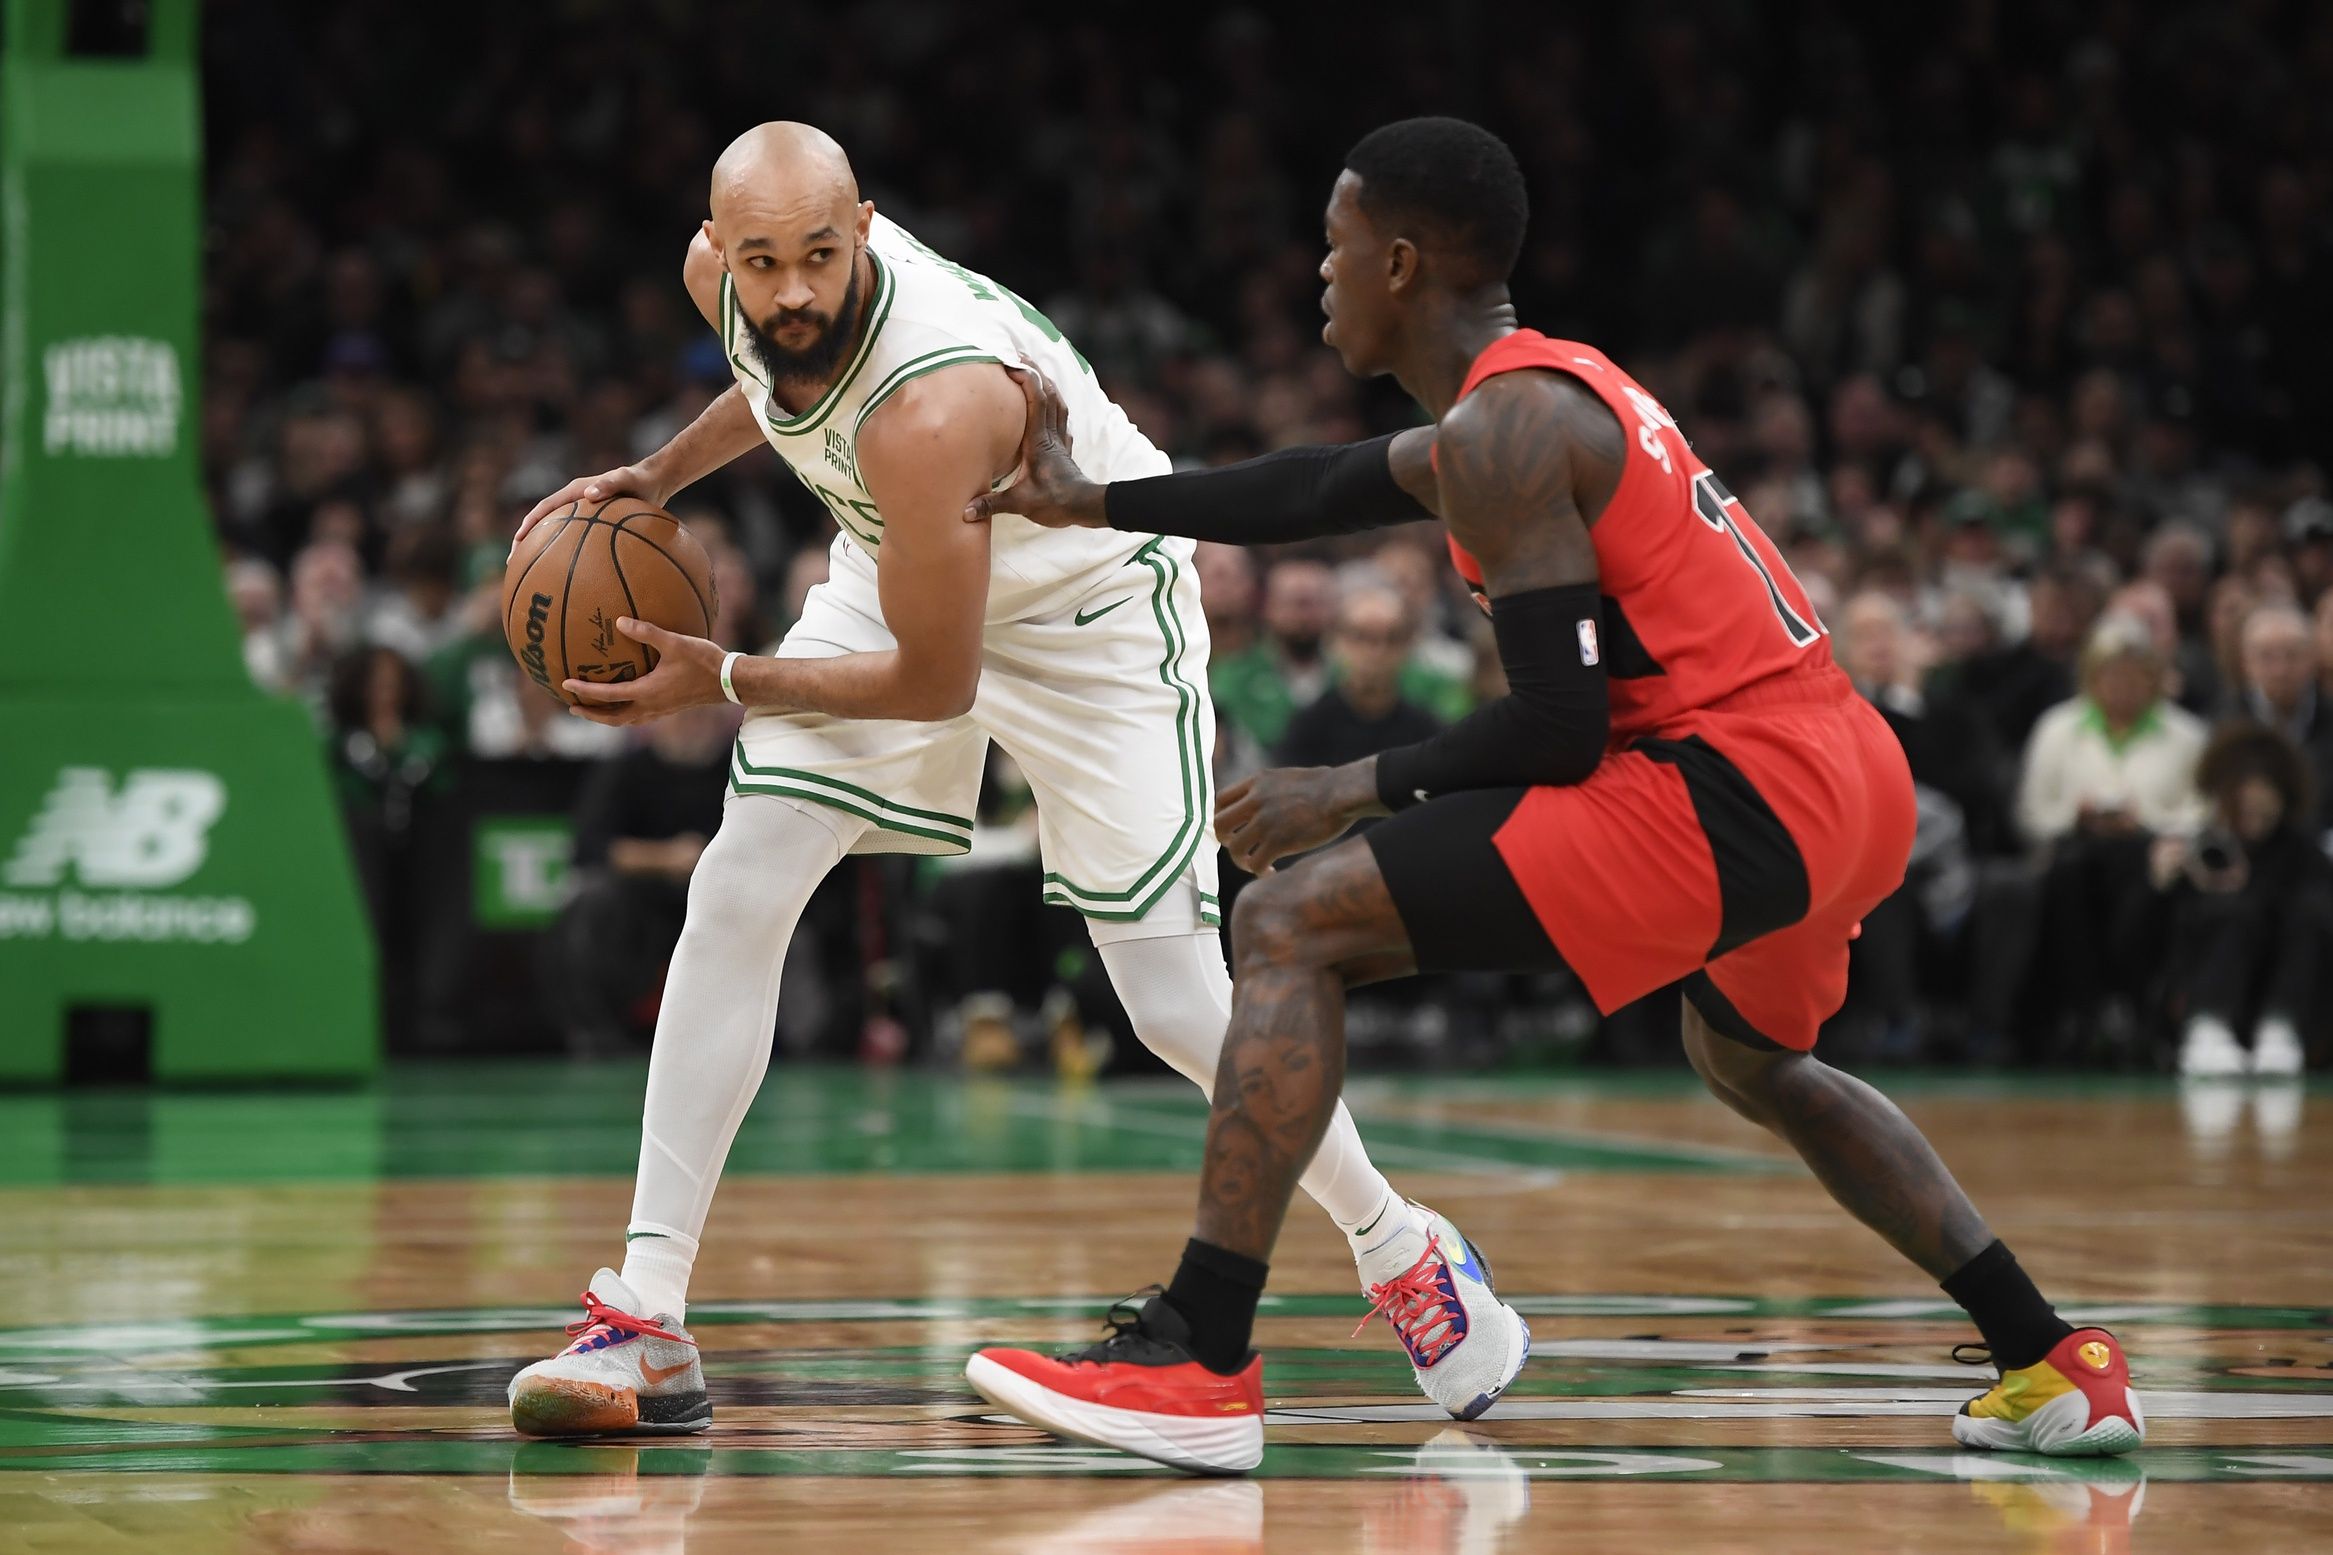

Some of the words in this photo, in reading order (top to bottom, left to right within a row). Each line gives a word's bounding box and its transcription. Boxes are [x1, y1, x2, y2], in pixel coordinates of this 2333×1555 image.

[44, 336, 181, 404] VISTA
[43, 409, 178, 456] PRINT
[824, 428, 851, 460] VISTA
[824, 447, 852, 480] PRINT
[1692, 469, 1829, 648] 1
[520, 591, 560, 700] ilson
[3, 767, 227, 887] NB
[0, 893, 51, 939] ew
[60, 887, 255, 943] balance
